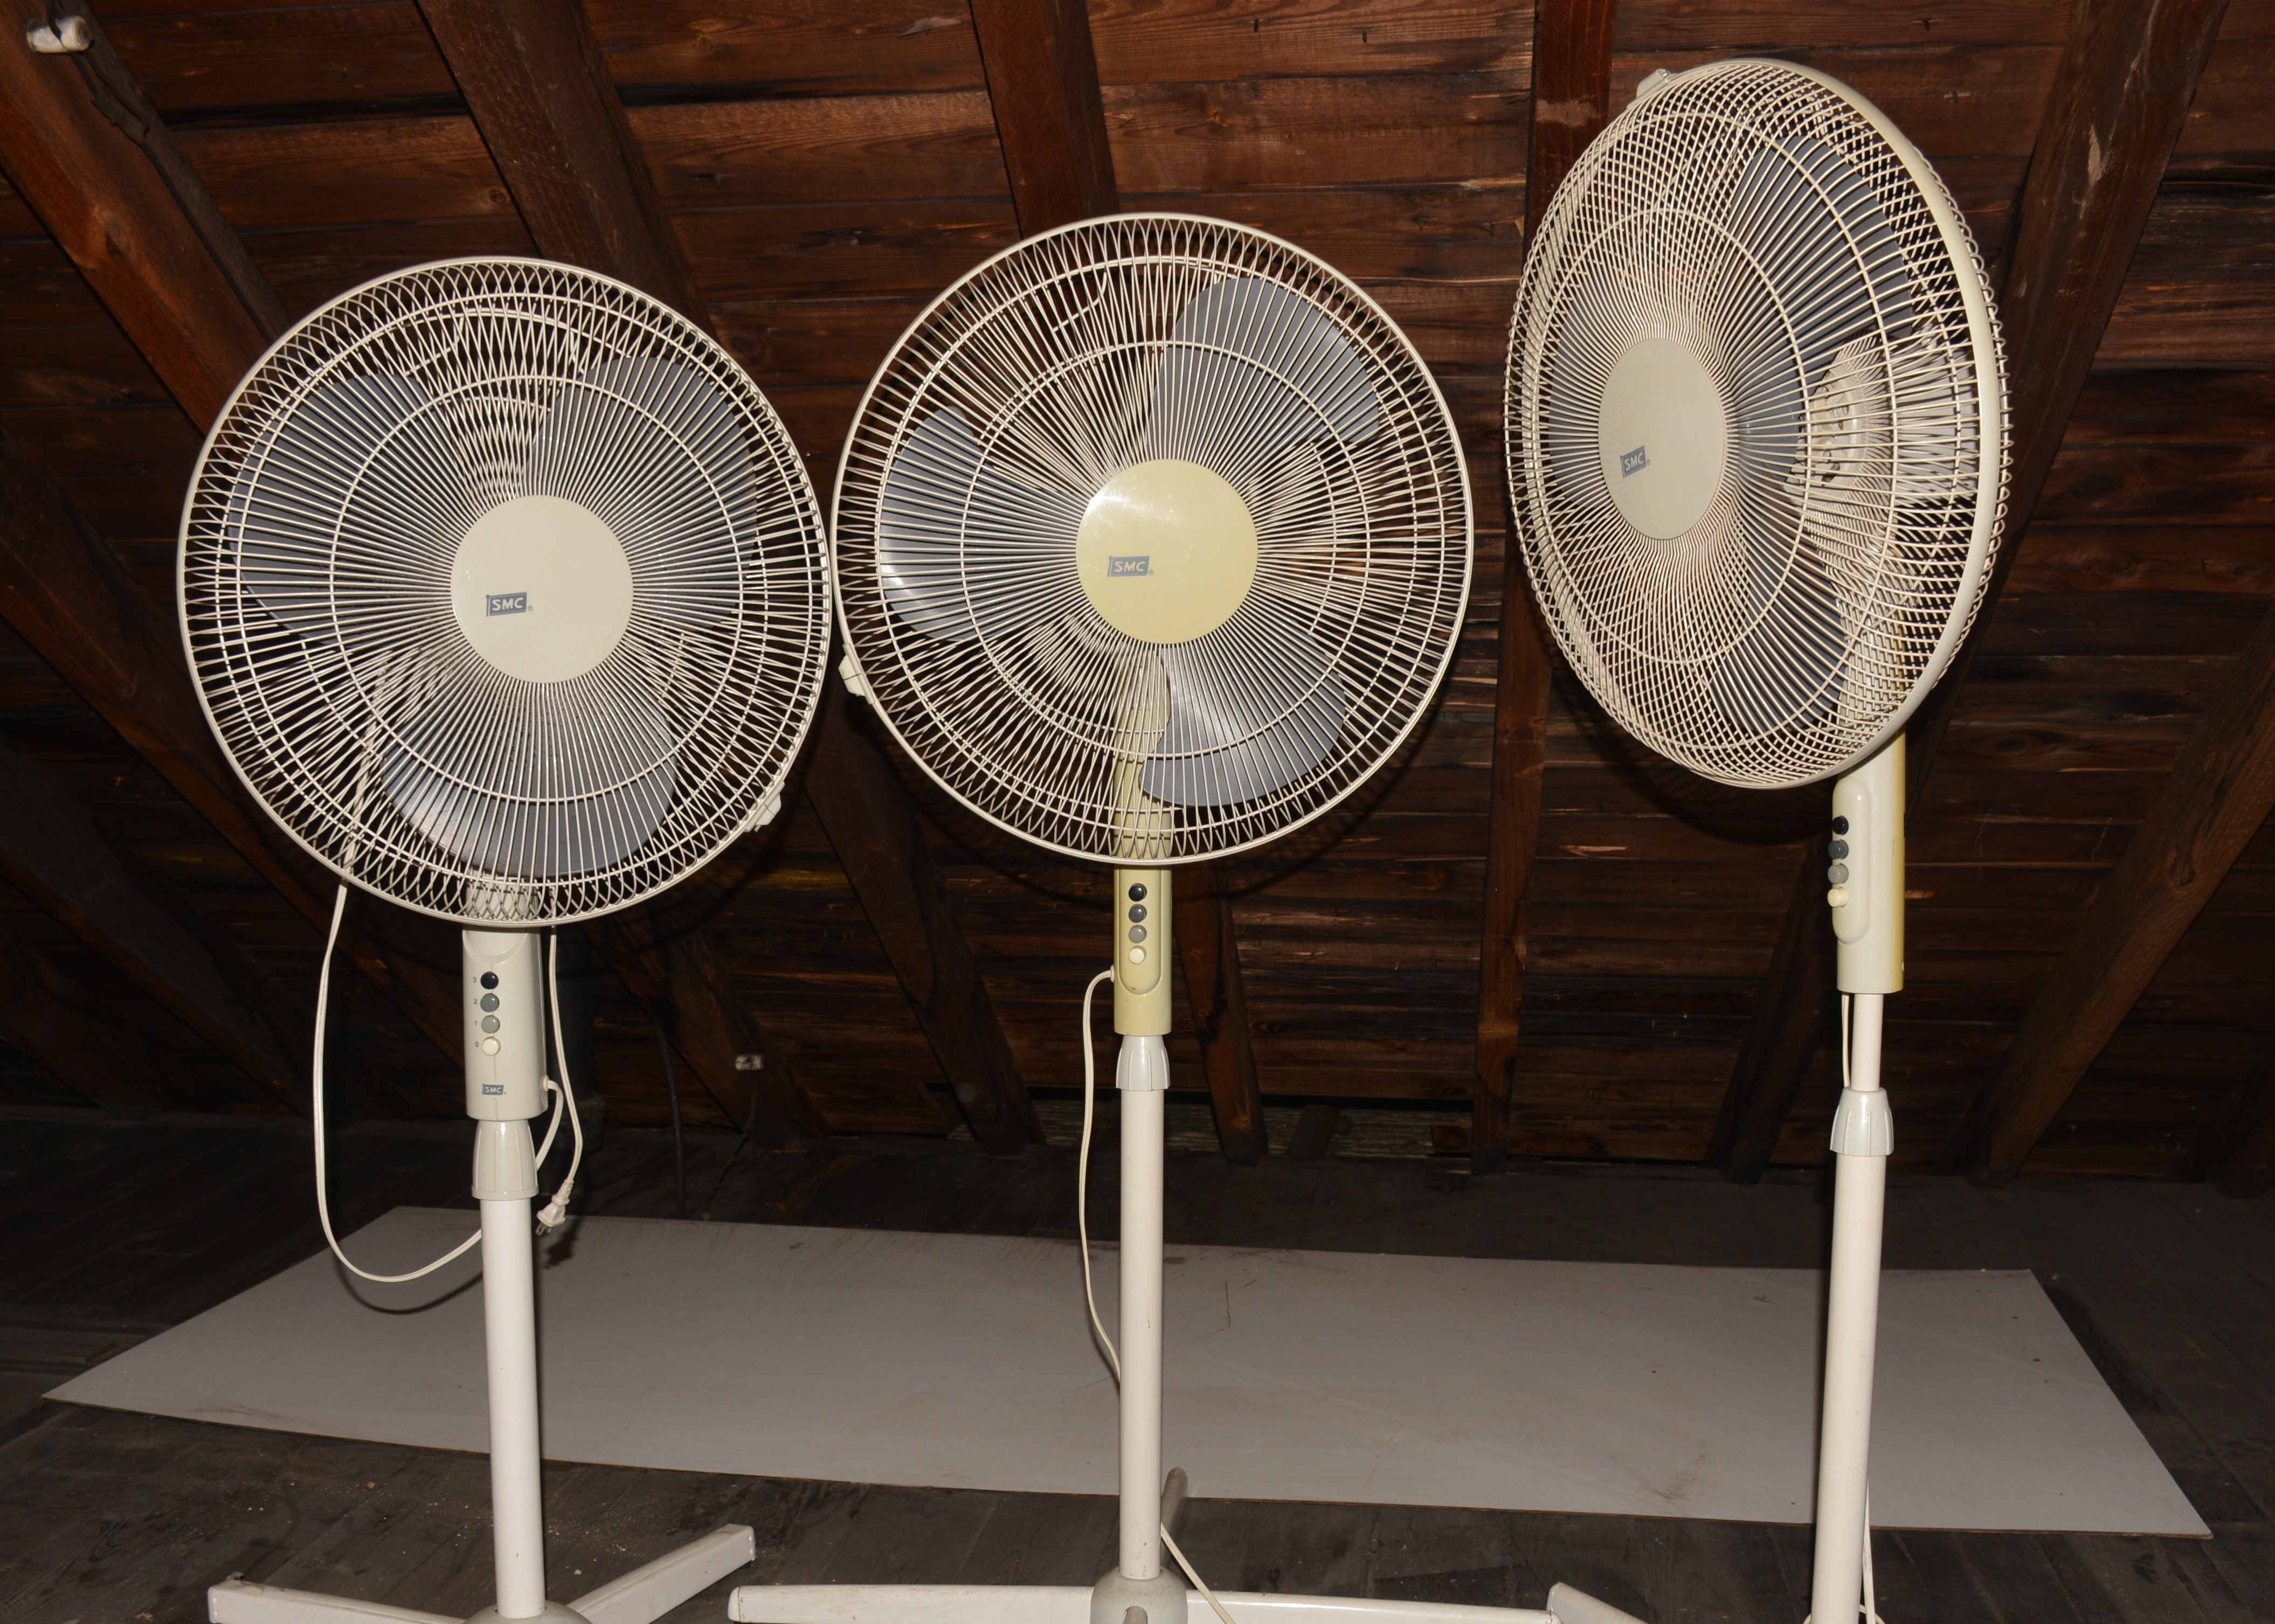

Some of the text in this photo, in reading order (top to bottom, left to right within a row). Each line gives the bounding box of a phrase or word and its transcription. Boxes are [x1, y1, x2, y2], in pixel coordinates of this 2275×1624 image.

[1624, 453, 1644, 471] SMC
[1114, 561, 1146, 572] SMC
[492, 597, 524, 611] SMC
